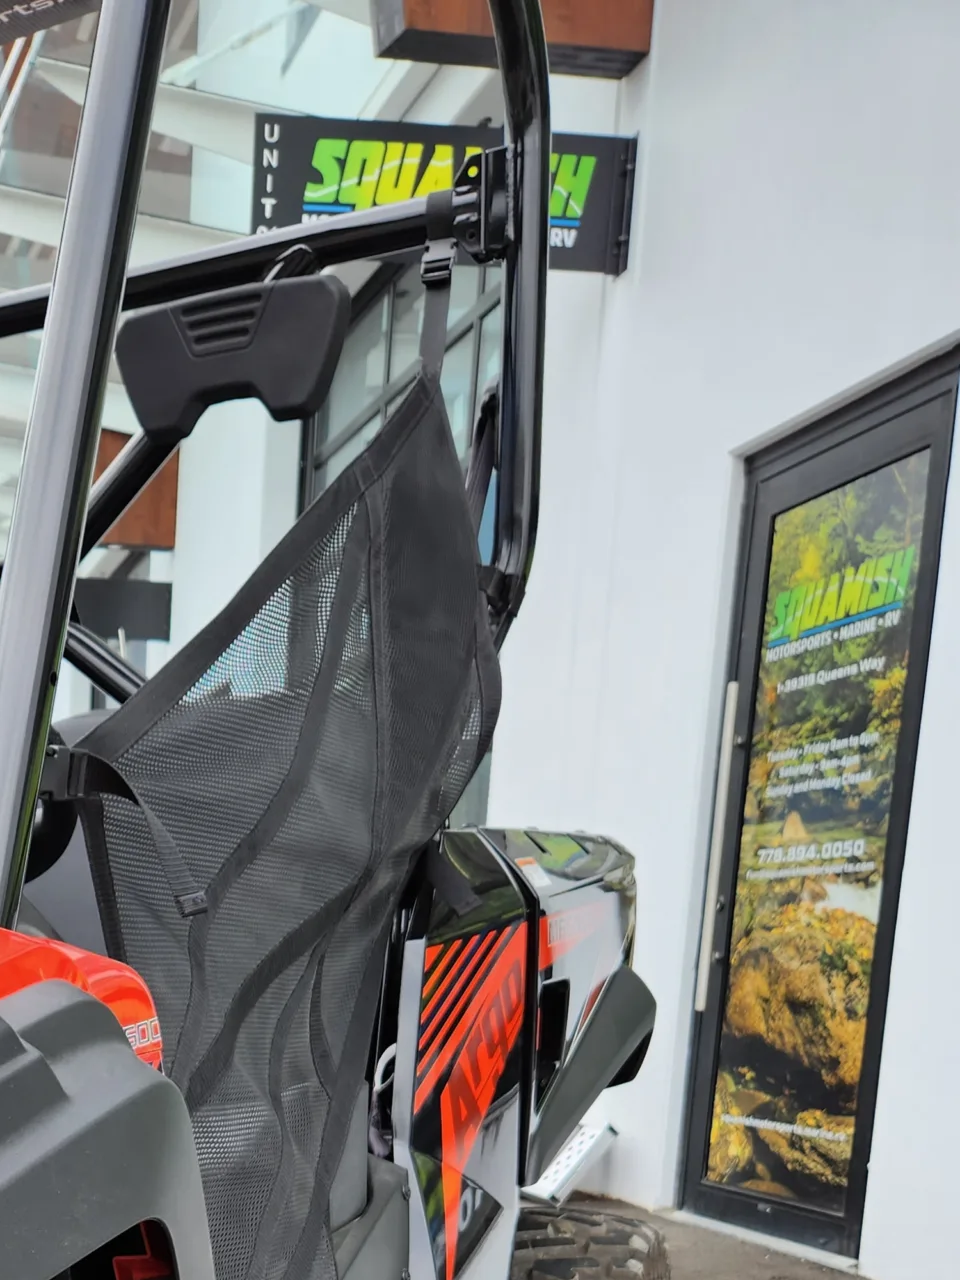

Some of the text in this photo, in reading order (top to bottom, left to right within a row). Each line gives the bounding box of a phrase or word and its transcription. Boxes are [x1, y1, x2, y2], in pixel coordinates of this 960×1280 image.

[260, 122, 280, 220] UNIT
[303, 138, 597, 218] SQUAH
[769, 544, 915, 641] SQUAMISH
[765, 609, 901, 662] MOTORSPORTS MARINE RV
[859, 656, 886, 673] Way
[842, 769, 871, 785] Closed
